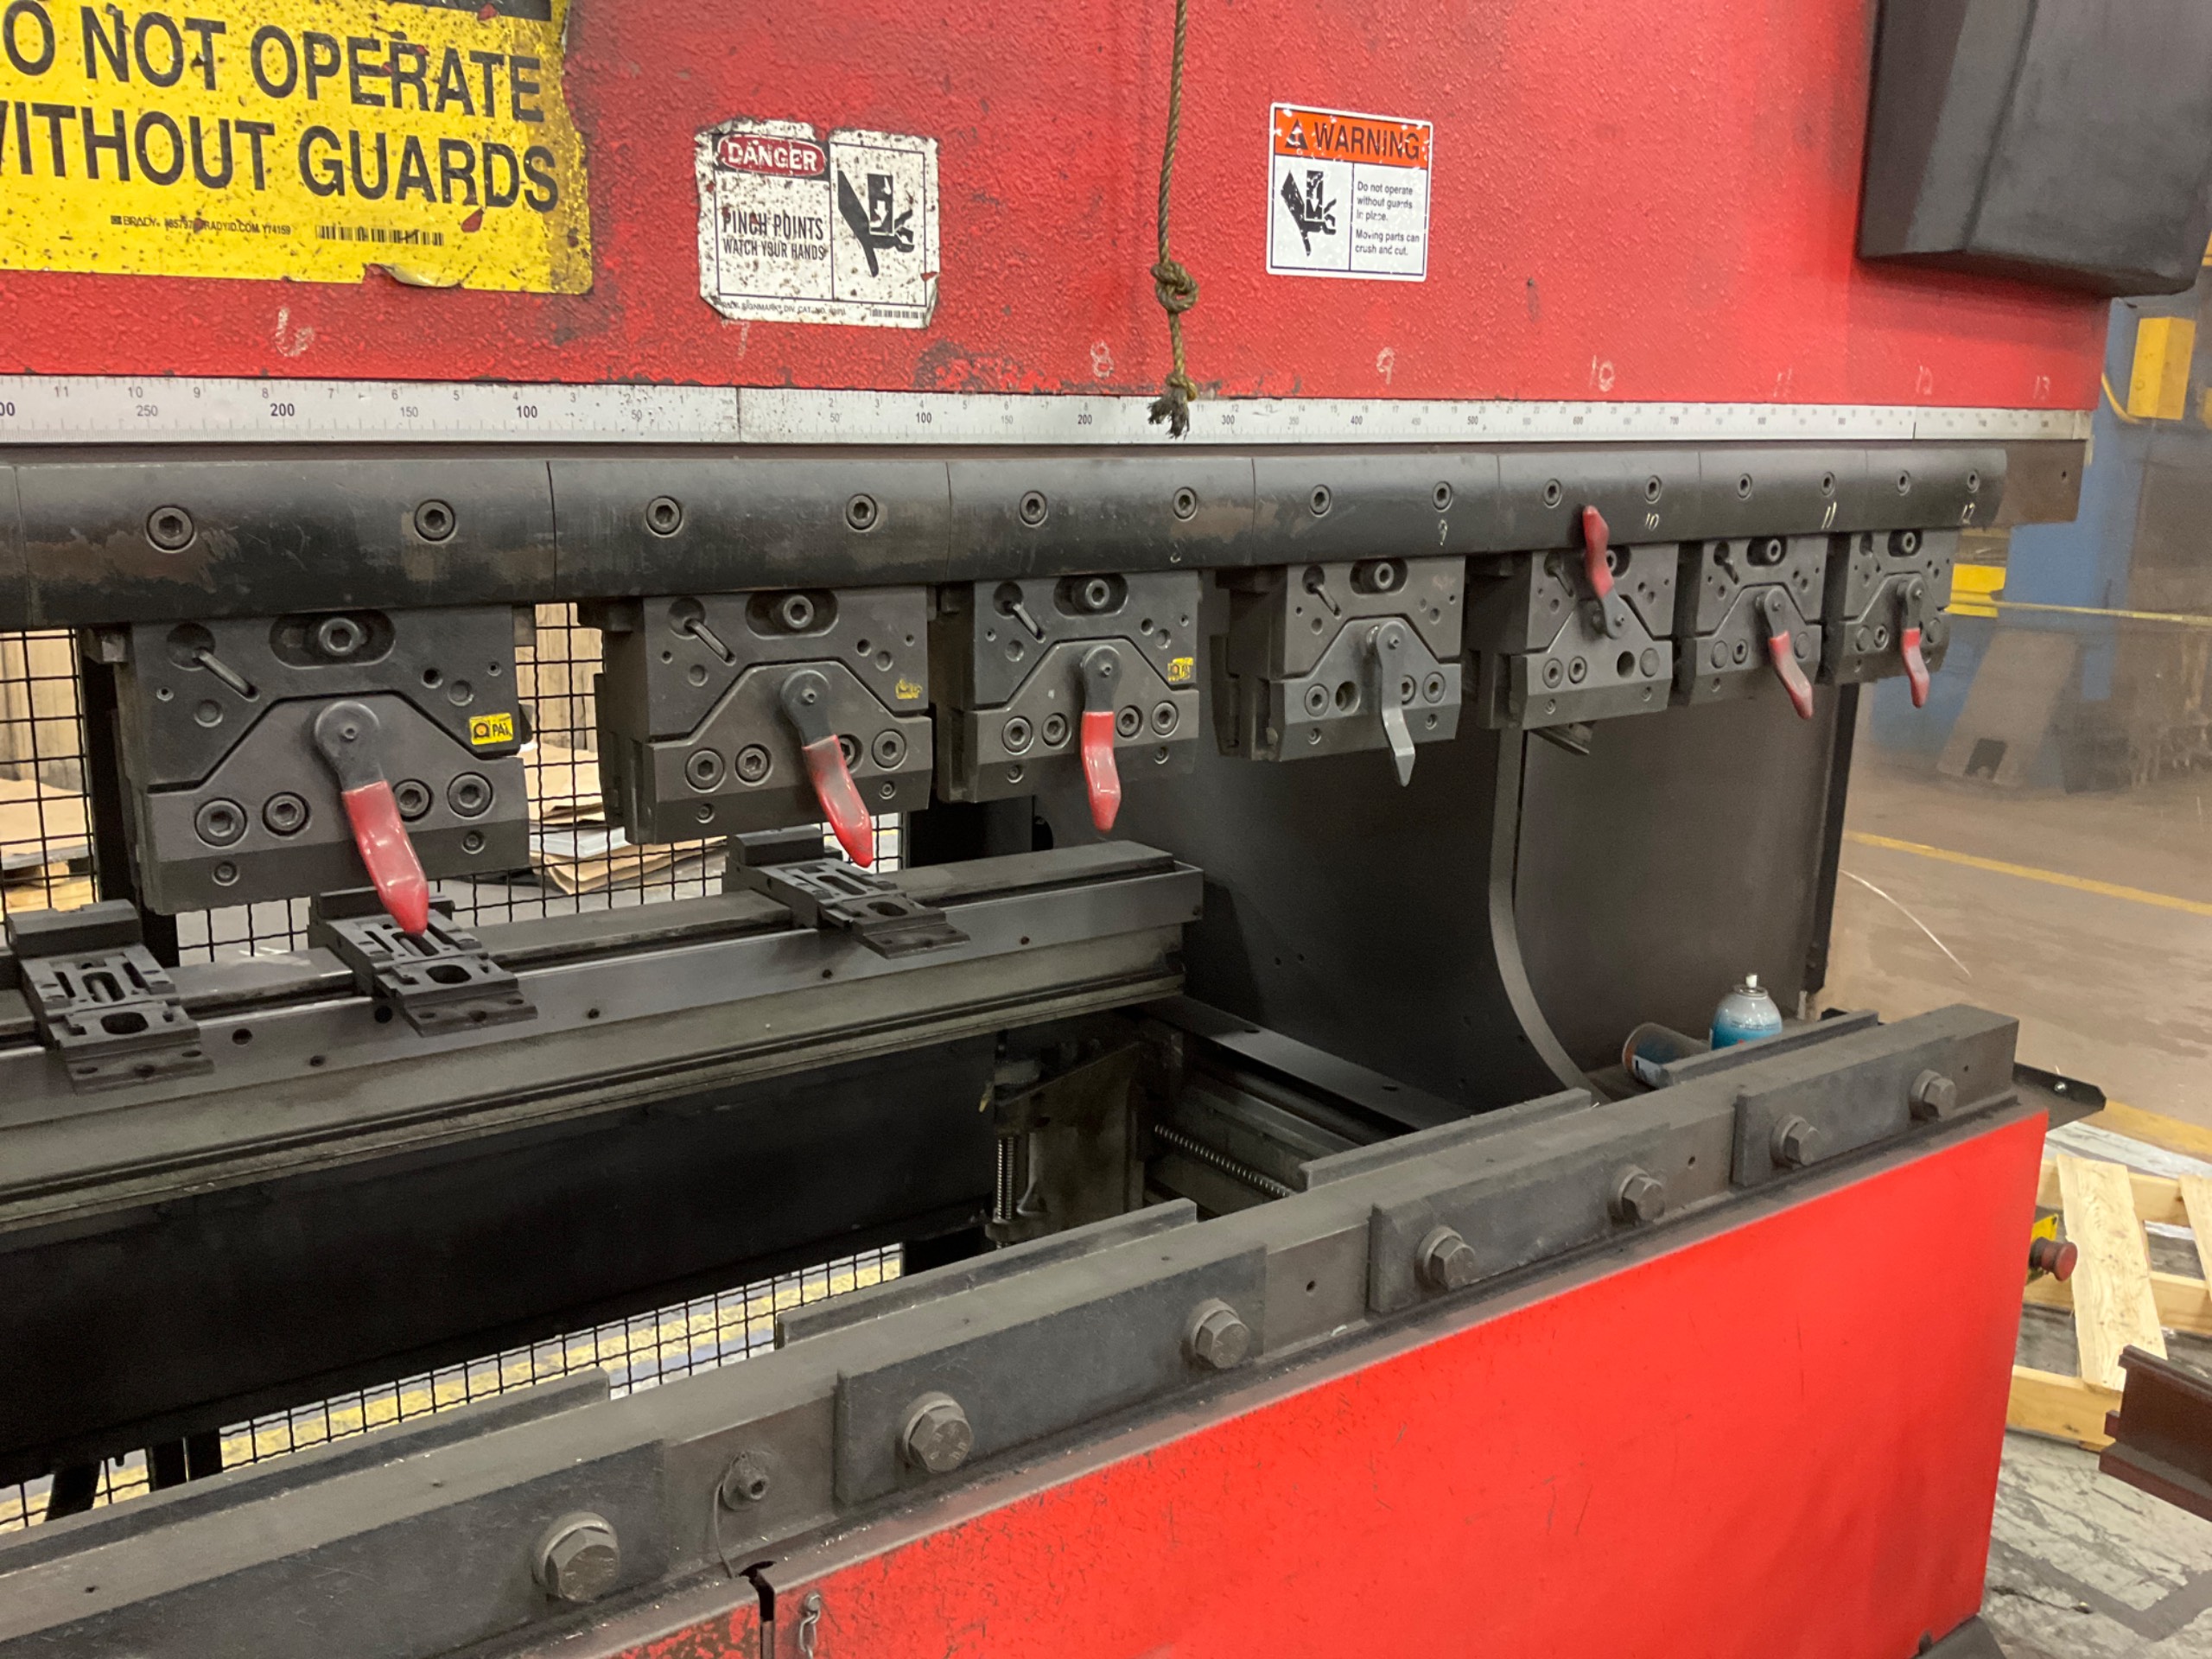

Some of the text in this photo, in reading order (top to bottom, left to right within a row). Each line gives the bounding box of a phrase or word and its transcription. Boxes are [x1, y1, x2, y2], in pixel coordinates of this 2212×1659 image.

[80, 6, 227, 92] NOT
[251, 24, 545, 124] OPERATE
[1313, 121, 1421, 161] WARNING
[726, 141, 818, 172] DANGER
[297, 126, 559, 213] GUARDS
[1357, 181, 1414, 197] Do not operate
[1357, 196, 1414, 210] without guards
[194, 219, 260, 234] RADYID.COM
[722, 208, 824, 241] PINCH POINTS
[1356, 229, 1420, 244] Moving parts can
[722, 238, 825, 261] WATCH YOUR HANDS
[1355, 245, 1376, 255] crush
[1379, 245, 1393, 255] and
[1090, 340, 1114, 378] 8
[1376, 346, 1395, 385] 9
[1589, 354, 1617, 392] 10
[54, 386, 69, 397] 11
[129, 386, 143, 398] 10
[194, 386, 200, 398] 9
[262, 388, 269, 399] 8
[328, 388, 334, 399] 7
[391, 389, 398, 401] 6
[454, 390, 461, 401] 5
[512, 391, 518, 401] 4
[569, 391, 576, 403] 3
[625, 393, 632, 404] 2
[829, 397, 834, 408] 2
[874, 397, 880, 409] 3
[918, 398, 924, 409] 4
[963, 400, 968, 410] 5
[1004, 400, 1009, 410] 6
[1197, 404, 1205, 412] 11
[1231, 404, 1239, 412] 12
[1298, 404, 1306, 413] 14
[1331, 404, 1338, 413] 15
[137, 405, 158, 416] 250
[270, 403, 296, 416] 200
[400, 406, 419, 417] 150
[516, 405, 538, 418] 100
[632, 409, 643, 422] 50
[830, 412, 840, 423] 50
[916, 412, 932, 423] 100
[1001, 415, 1014, 424] 150
[1077, 414, 1093, 425] 200
[1221, 414, 1235, 425] 300
[1350, 416, 1363, 426] 400
[1467, 416, 1478, 425] 500
[1437, 518, 1448, 546] 9
[1644, 512, 1659, 531] 10
